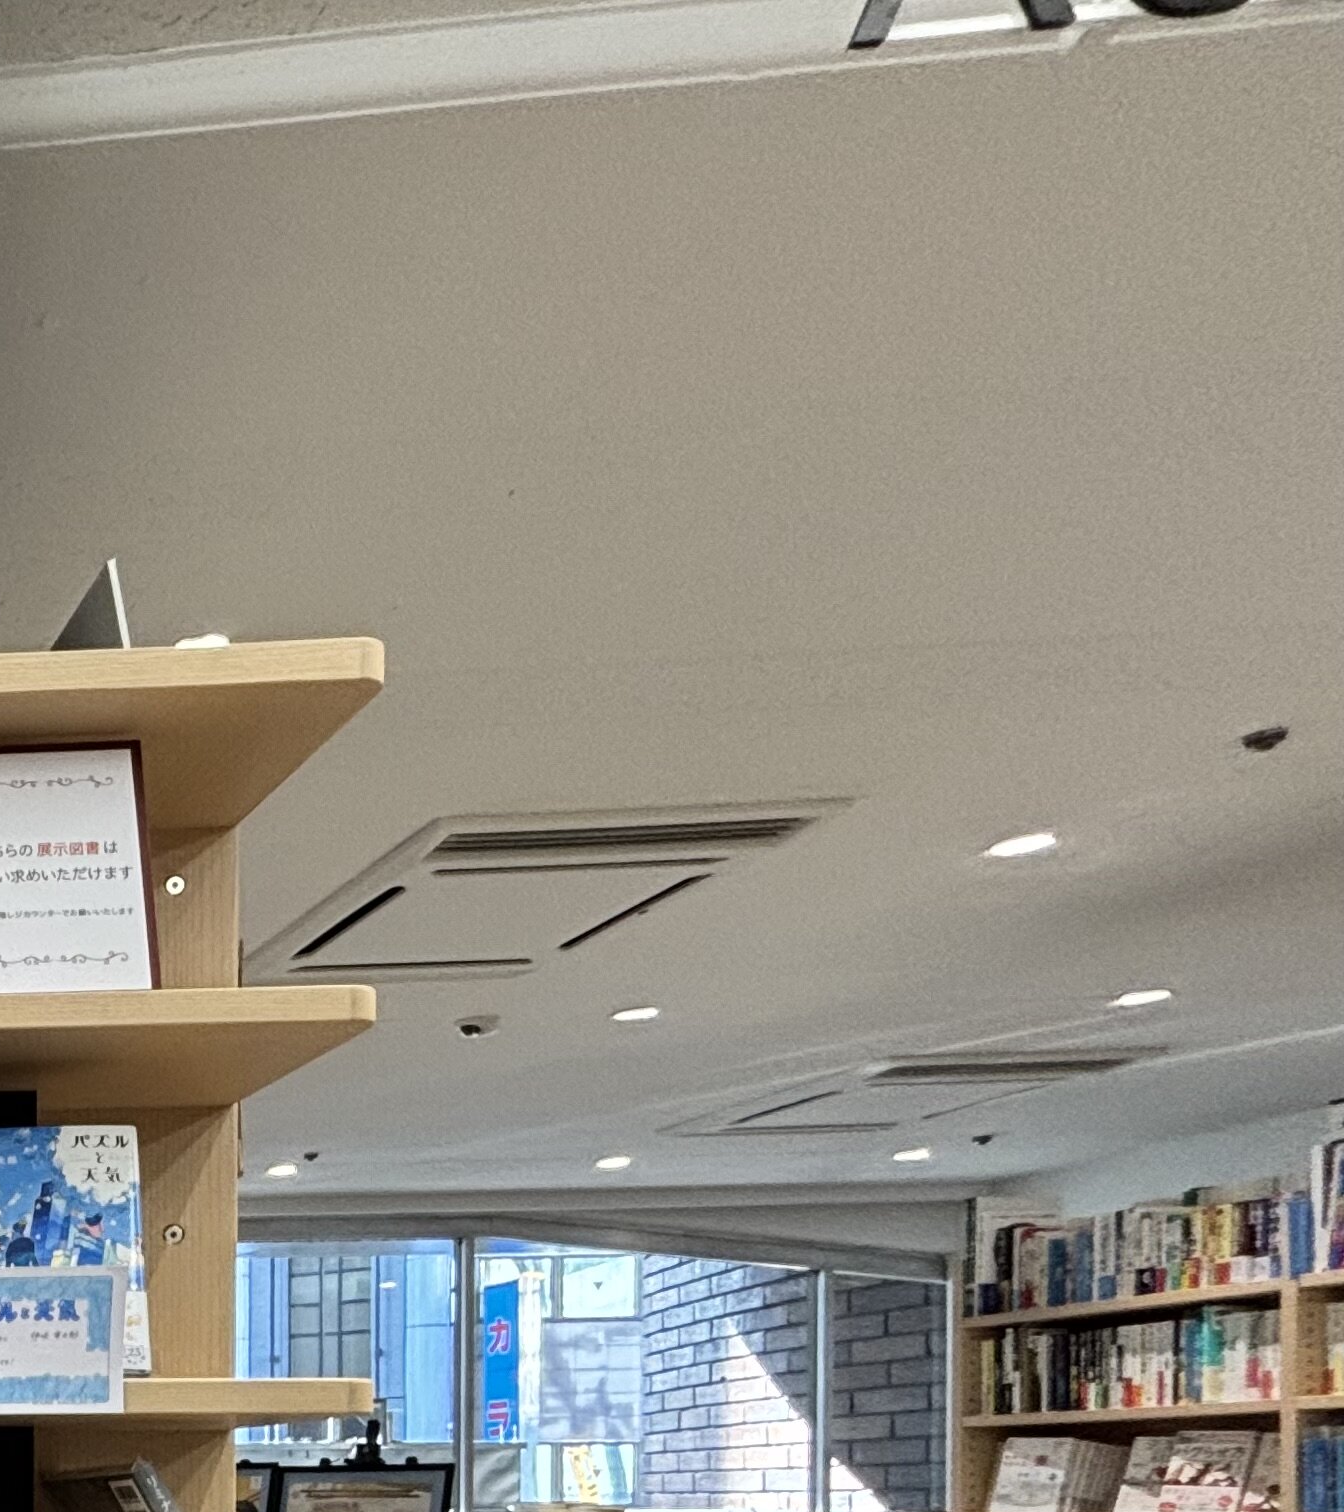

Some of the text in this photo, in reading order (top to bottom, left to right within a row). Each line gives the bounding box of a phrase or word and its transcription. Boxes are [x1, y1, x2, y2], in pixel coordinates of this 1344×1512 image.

[72, 1134, 130, 1149] パズル
[95, 1151, 105, 1164] と
[81, 1167, 125, 1184] 天気
